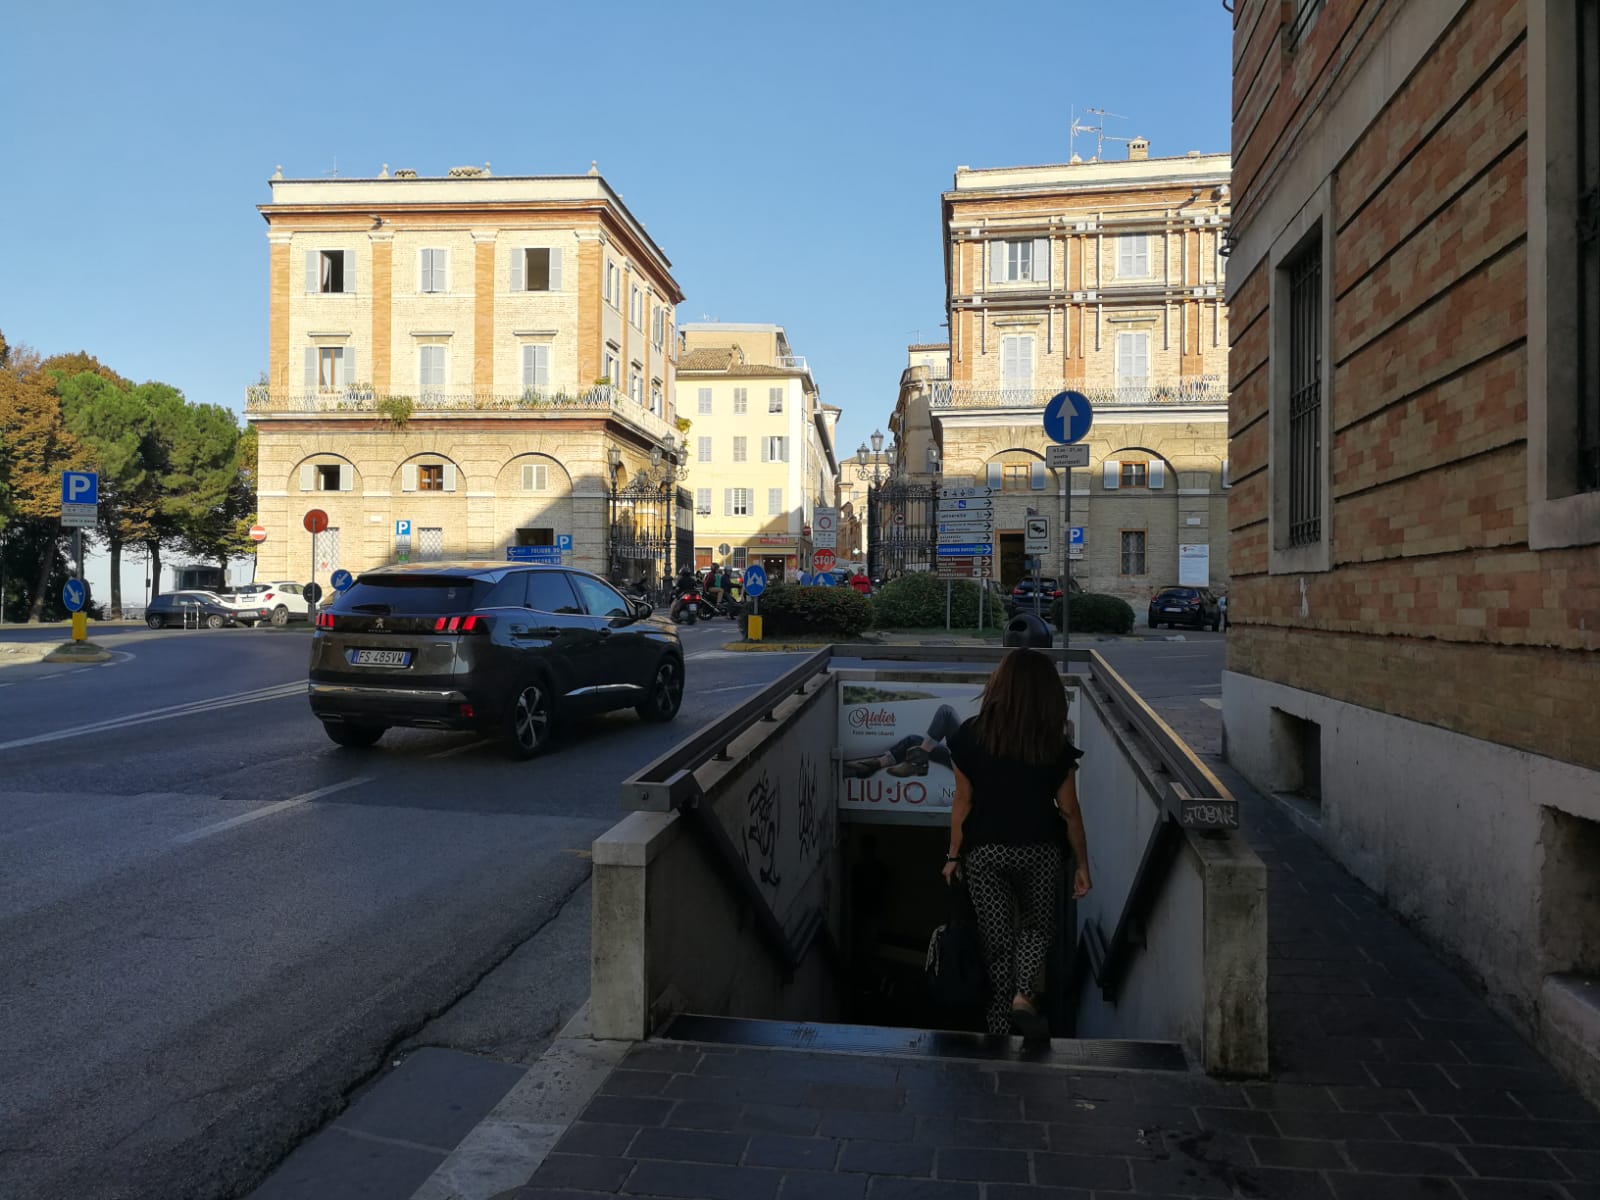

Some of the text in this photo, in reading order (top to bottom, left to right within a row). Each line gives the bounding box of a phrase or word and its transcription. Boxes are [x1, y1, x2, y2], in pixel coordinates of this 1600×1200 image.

[69, 475, 91, 501] P
[398, 521, 409, 534] P
[559, 535, 570, 549] P
[1070, 529, 1081, 542] P
[814, 555, 836, 565] STOP
[848, 706, 898, 730] Atelier
